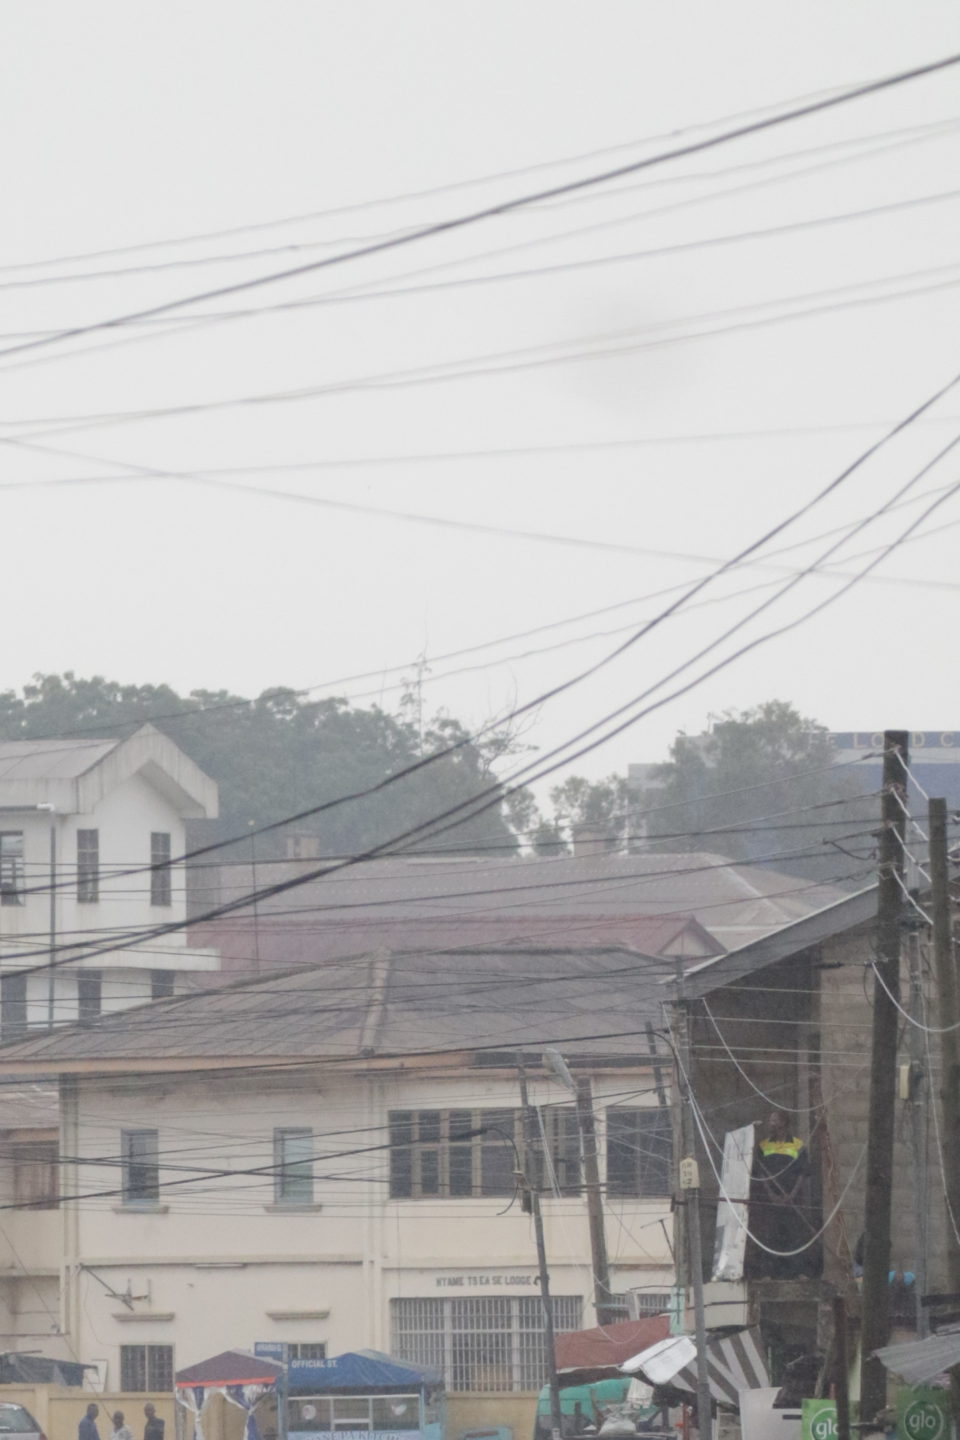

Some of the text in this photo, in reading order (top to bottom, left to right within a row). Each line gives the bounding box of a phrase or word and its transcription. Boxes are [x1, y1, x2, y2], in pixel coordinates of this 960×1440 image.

[853, 732, 925, 748] LOD
[291, 1359, 325, 1369] OFFICIAL
[909, 1410, 936, 1434] glo
